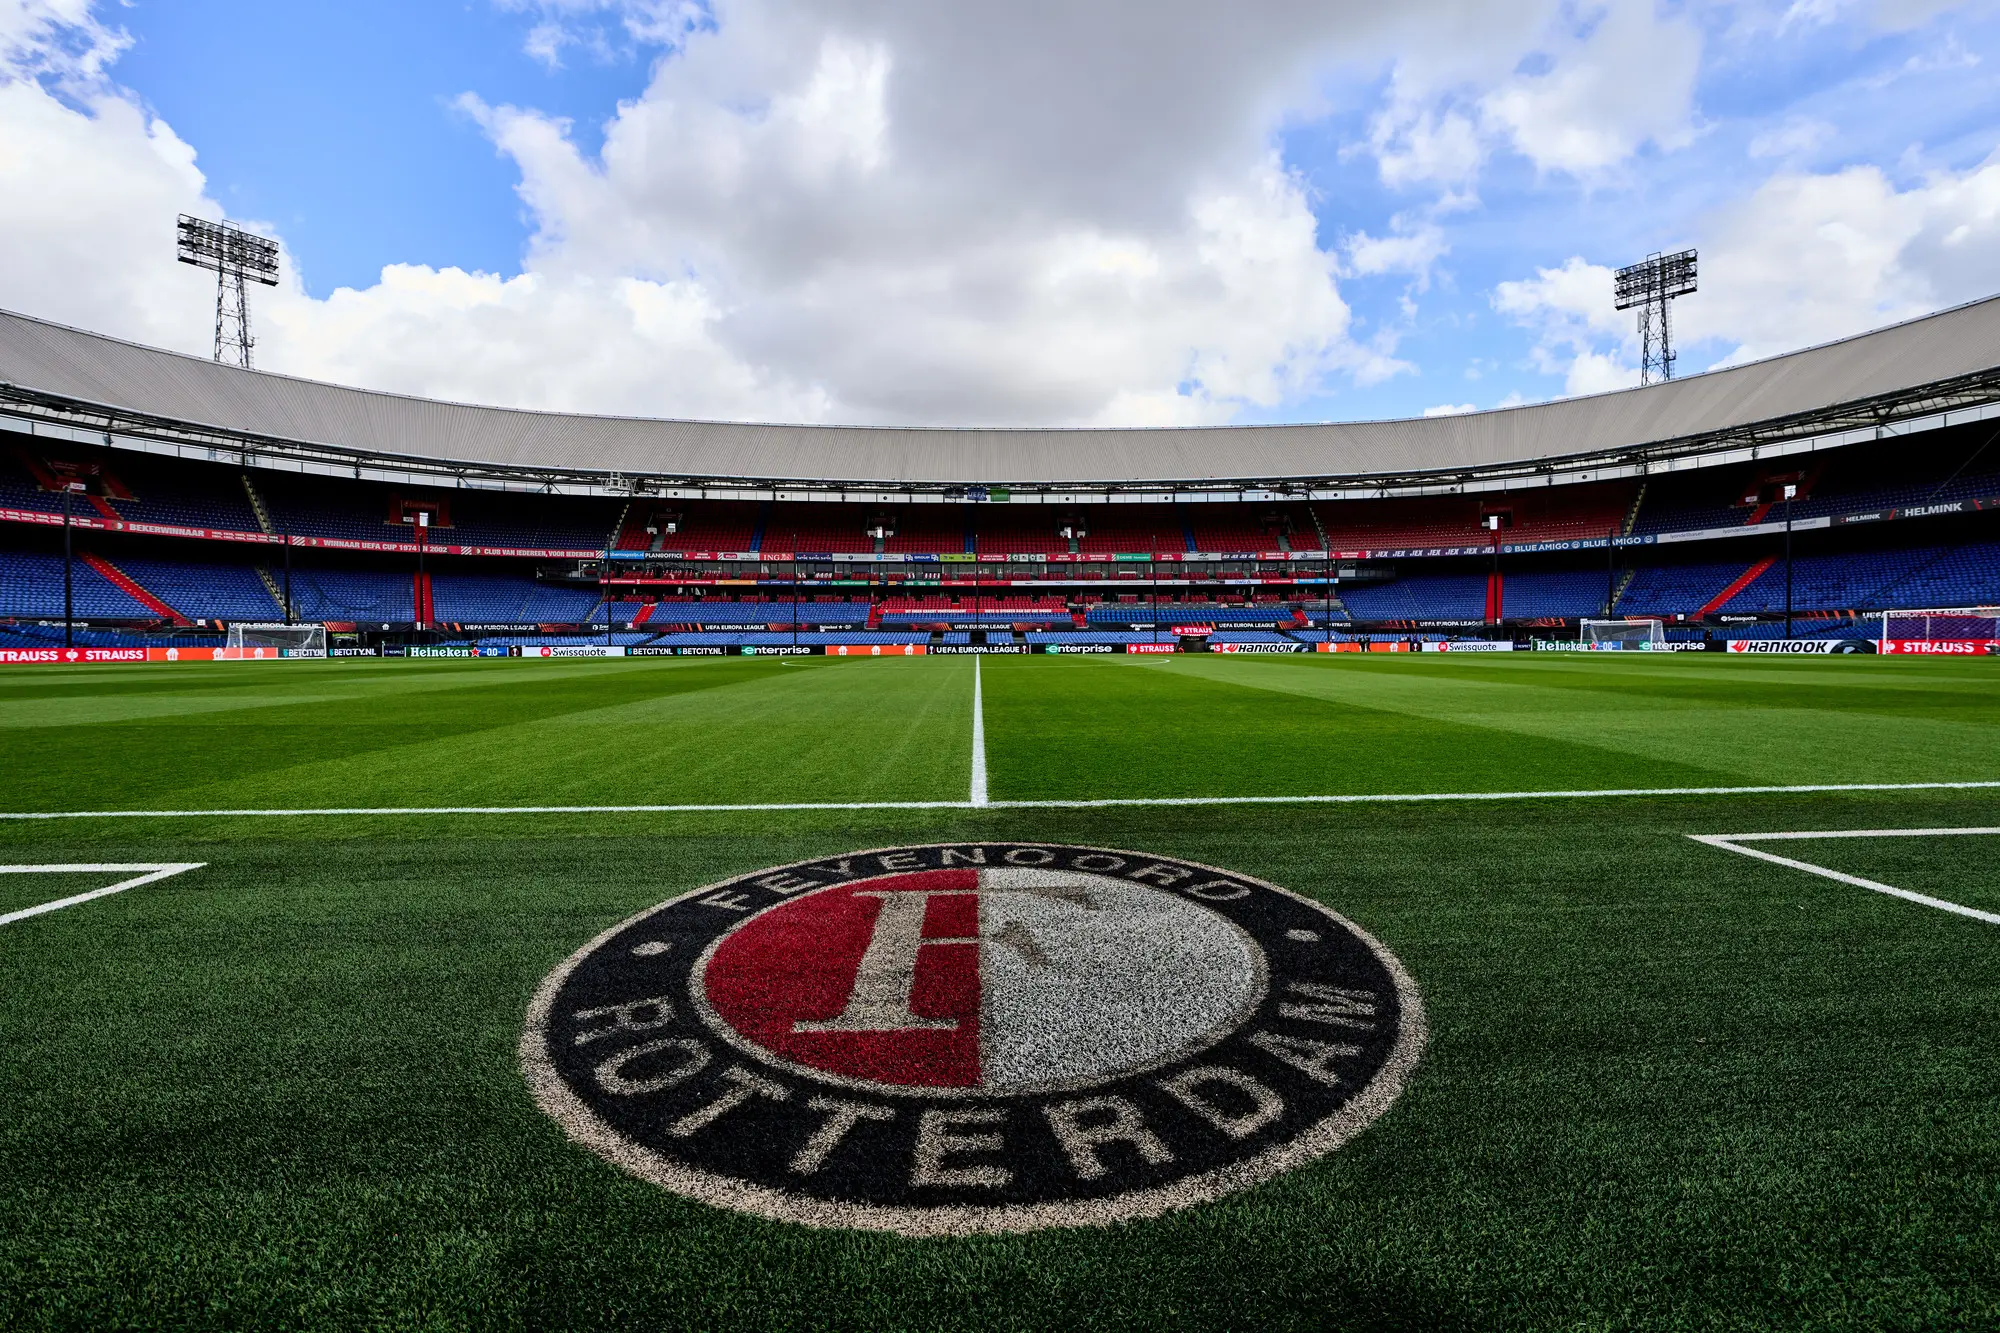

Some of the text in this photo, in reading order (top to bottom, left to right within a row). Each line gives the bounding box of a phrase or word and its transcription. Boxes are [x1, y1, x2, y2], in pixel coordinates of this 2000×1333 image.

[1904, 502, 1962, 517] HELMINK
[1845, 513, 1881, 522] HELMINK
[129, 523, 205, 537] BEKERWINNAAR
[323, 539, 360, 549] WINNAAR
[361, 541, 381, 550] UEFA
[382, 542, 397, 551] CUP
[399, 544, 417, 552] 1974
[430, 545, 447, 553] 2002
[1538, 543, 1569, 552] AMIGO
[1583, 540, 1607, 548] BLUE
[484, 548, 501, 556] CLUB
[502, 548, 515, 556] VAN
[742, 645, 811, 656] enterprise
[1046, 644, 1112, 654] enterprise
[1449, 642, 1497, 651] Swissquote
[1536, 640, 1589, 651] Heineken
[1640, 640, 1706, 652] enterprise
[1903, 642, 1975, 653] STRAUSS
[0, 651, 58, 661] TRAUSS
[85, 650, 144, 660] STRAUSS
[410, 647, 470, 657] Heineken
[552, 647, 607, 657] Swissquote
[703, 847, 1253, 912] FEYENOORD
[574, 982, 1378, 1190] ROTTERDAM
